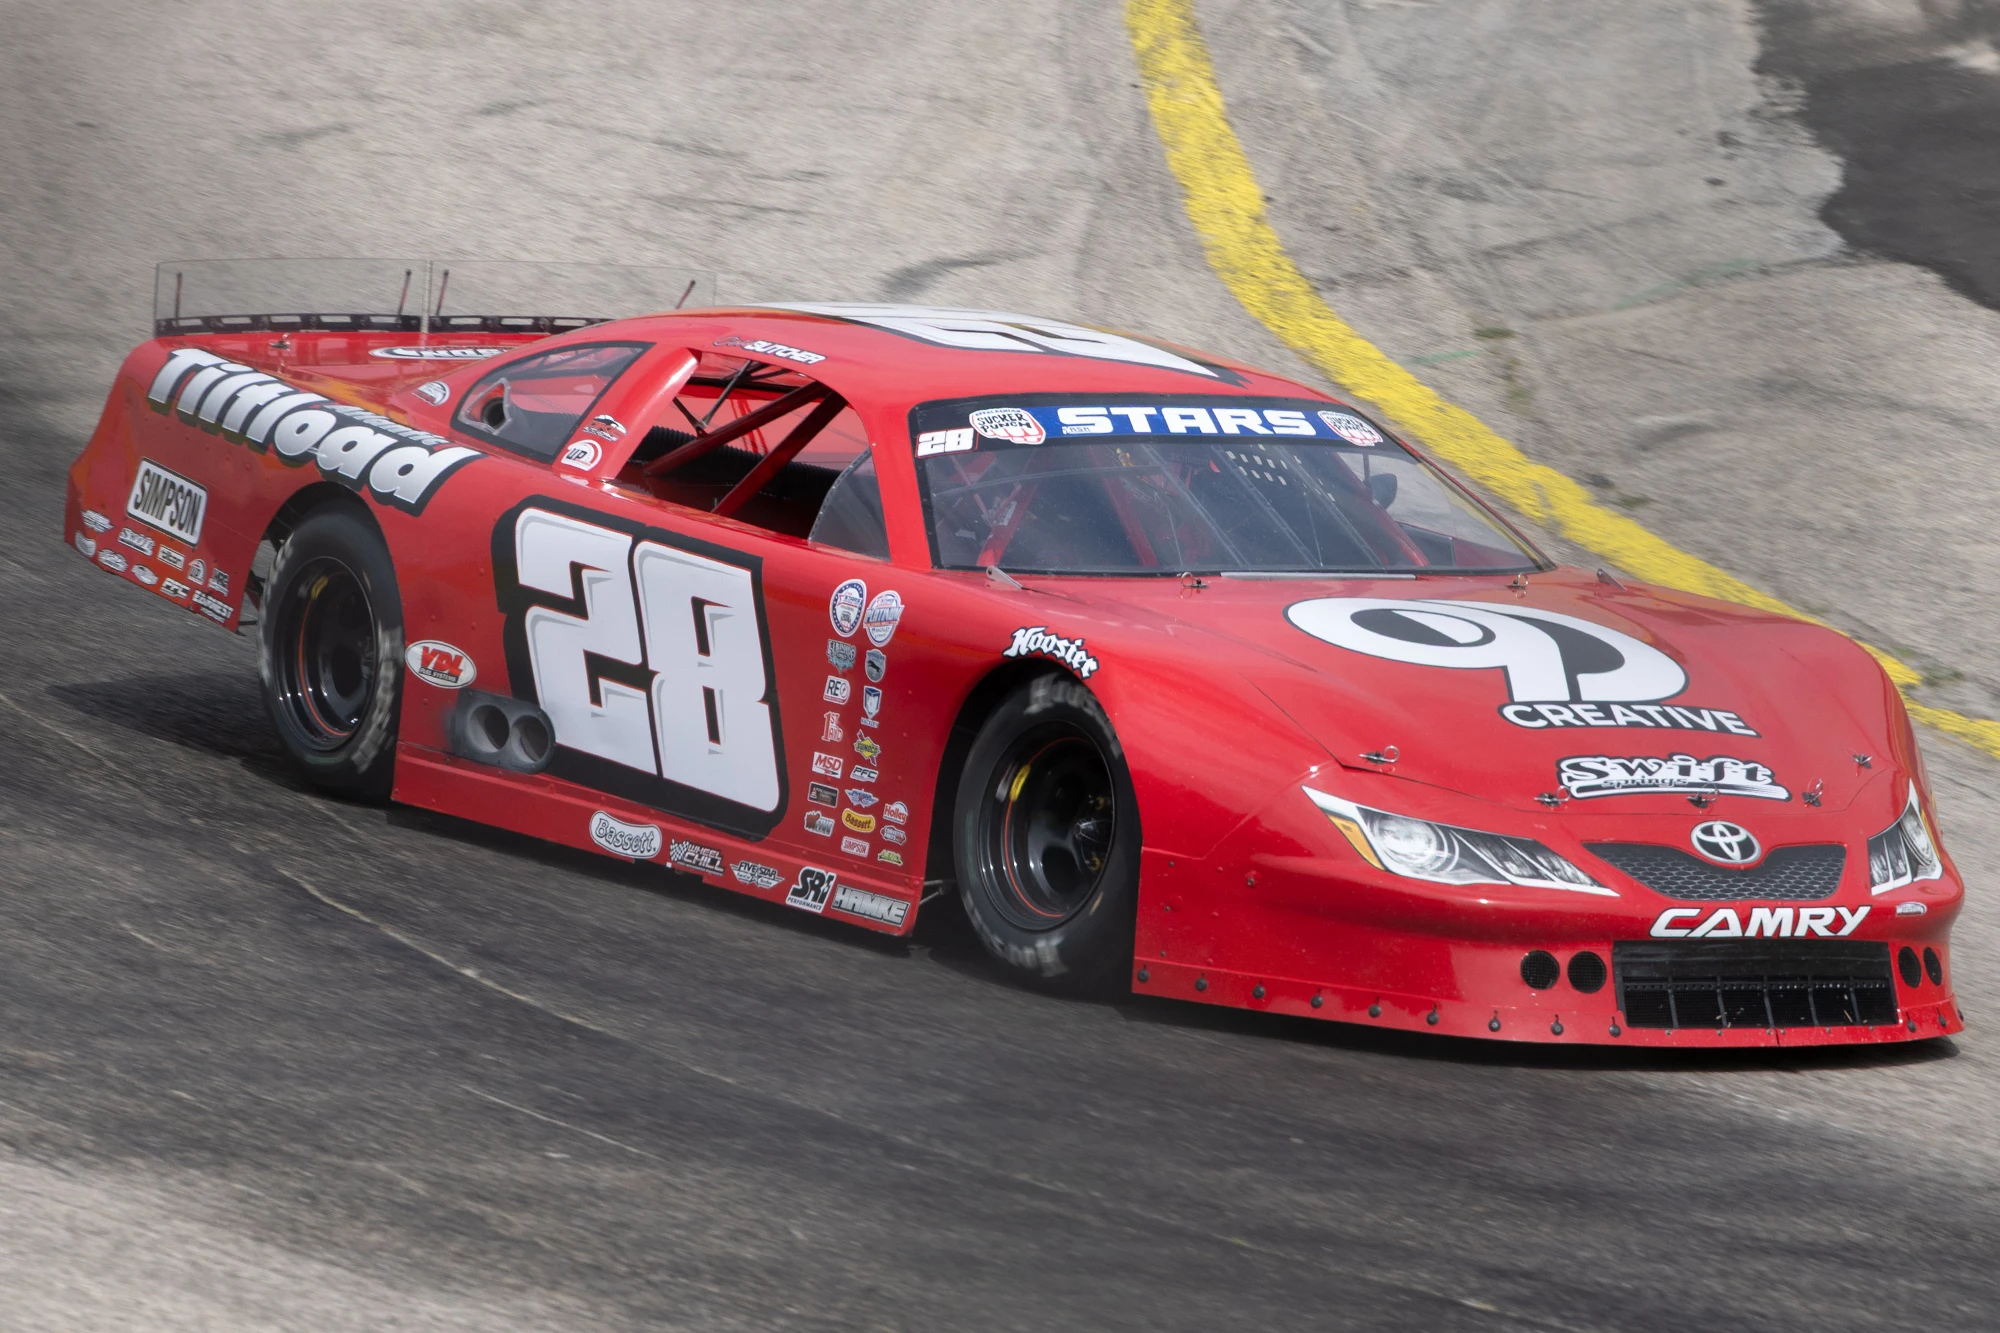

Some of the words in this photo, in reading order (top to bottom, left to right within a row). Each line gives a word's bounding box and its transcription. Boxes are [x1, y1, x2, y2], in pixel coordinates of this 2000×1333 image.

[743, 340, 827, 365] BUTCHER
[976, 413, 1028, 426] SUCKER
[980, 421, 1033, 433] PUNCH
[1057, 406, 1317, 436] STARS
[917, 428, 974, 457] 28
[134, 466, 203, 537] SIMPSON
[420, 645, 464, 677] VDL
[515, 507, 780, 812] 28
[1002, 626, 1099, 679] Hoosier
[1501, 703, 1758, 736] CREATIVE
[855, 742, 879, 755] SUNOCO
[814, 754, 842, 771] MSD
[1560, 755, 1774, 786] Swift
[852, 767, 878, 780] PFC
[1601, 776, 1690, 789] springs
[883, 803, 908, 823] Holley
[688, 843, 722, 860] WHEEL
[843, 838, 868, 854] SIMPSON
[683, 852, 724, 873] CHILL
[739, 861, 758, 873] FIVE
[758, 867, 777, 881] STAR
[787, 897, 823, 911] PERFORMANCE
[834, 886, 909, 926] HAMKE
[1648, 905, 1872, 938] CAMRY
